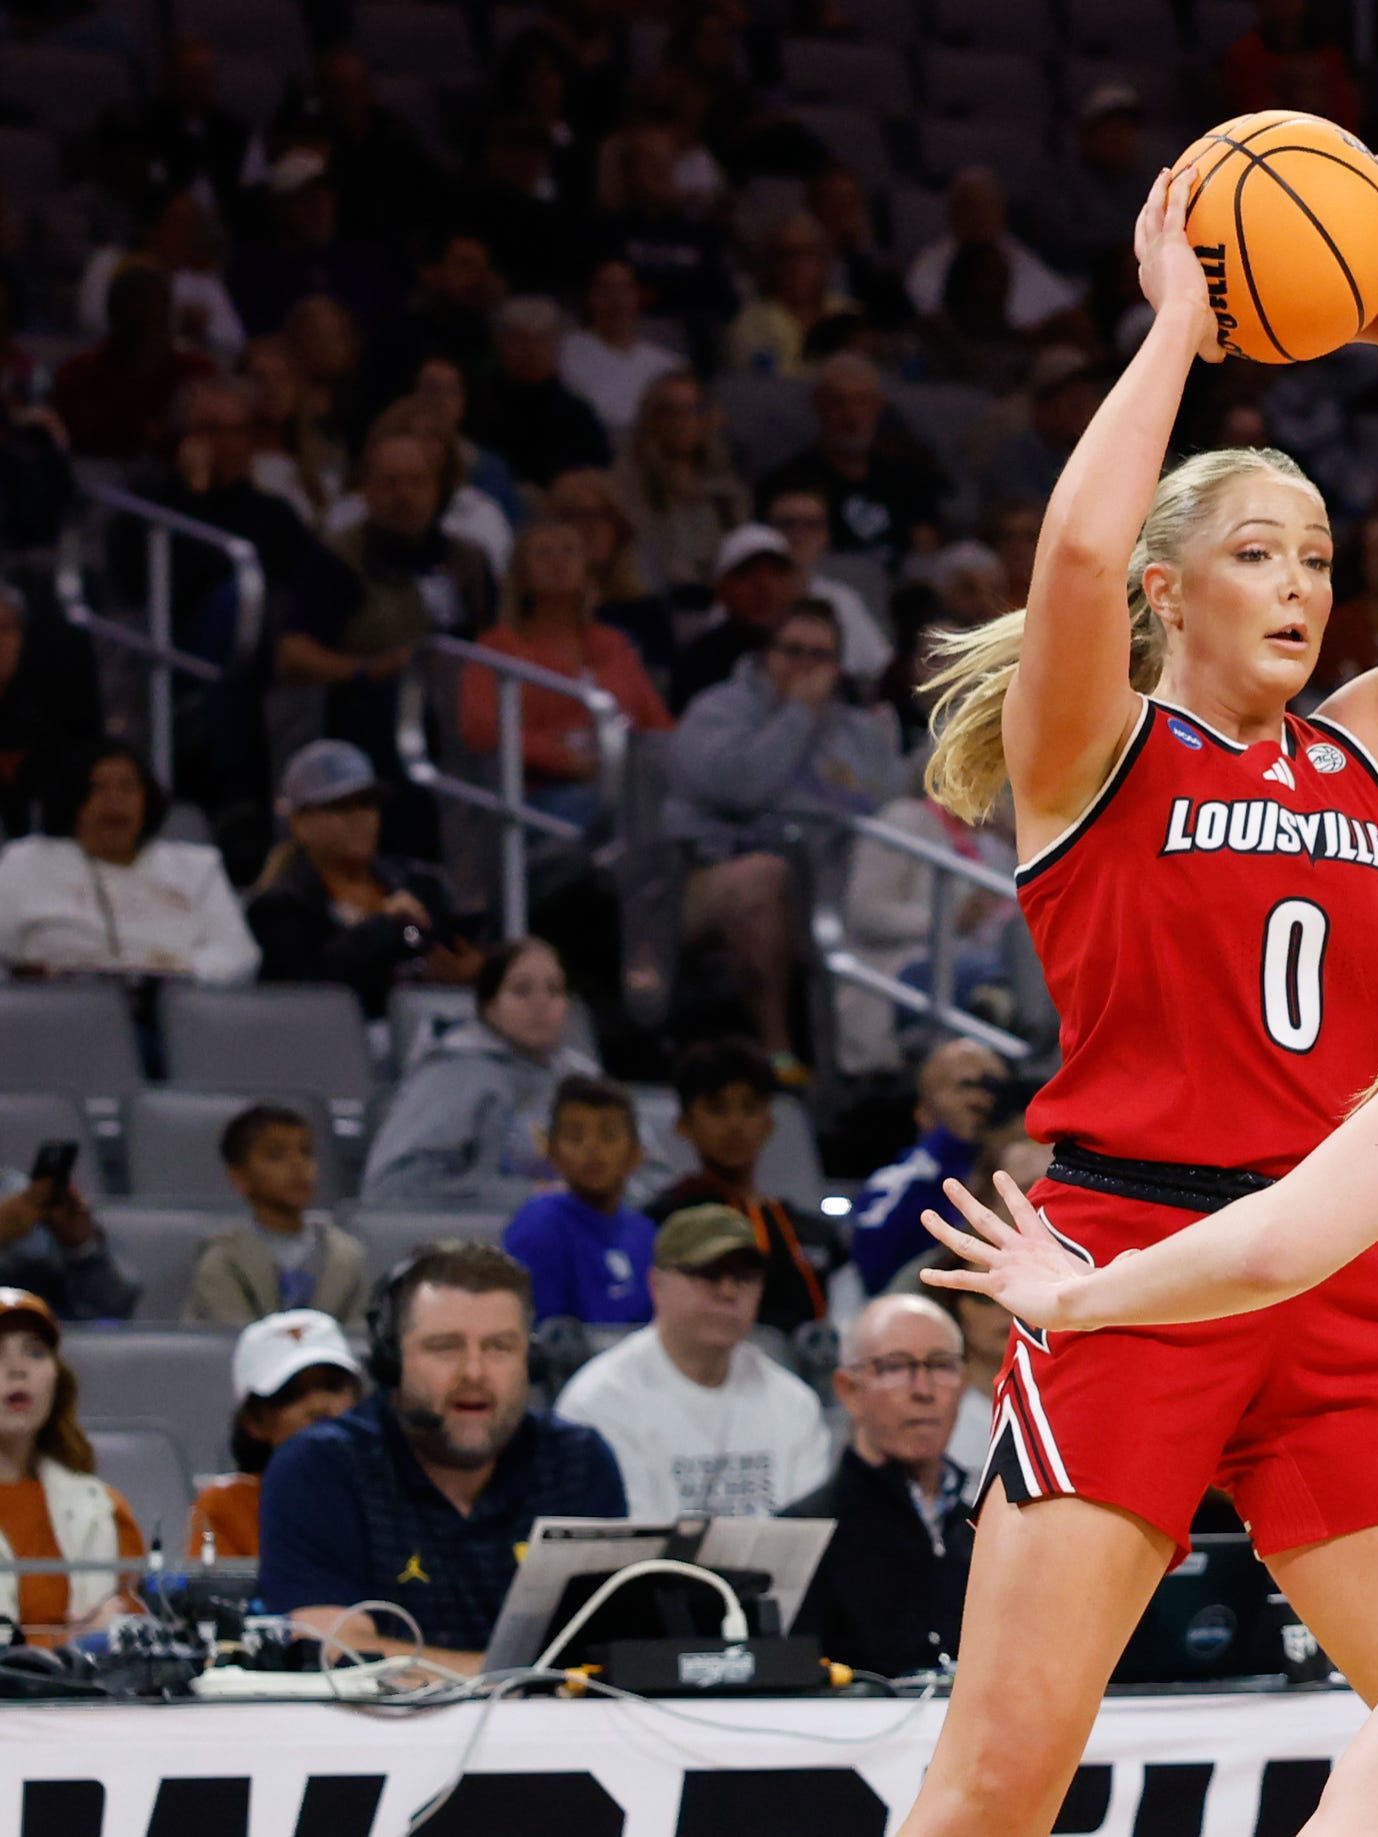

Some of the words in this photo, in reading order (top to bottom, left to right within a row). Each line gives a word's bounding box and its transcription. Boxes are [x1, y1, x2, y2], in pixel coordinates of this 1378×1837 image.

[1173, 728, 1202, 748] NCAA
[1312, 751, 1341, 766] ACC
[1260, 895, 1330, 1055] 0
